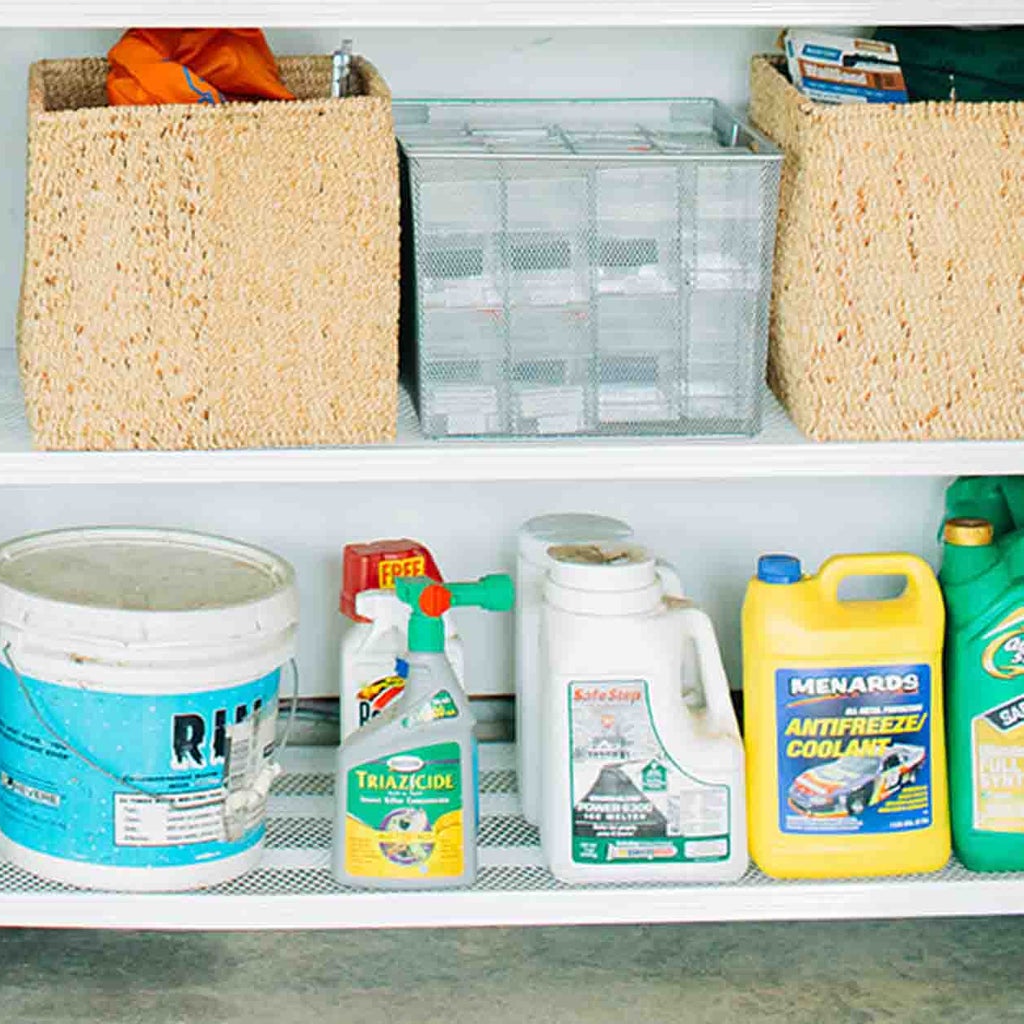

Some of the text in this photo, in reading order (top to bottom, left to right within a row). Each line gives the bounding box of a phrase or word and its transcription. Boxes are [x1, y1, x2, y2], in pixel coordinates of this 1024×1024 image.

[381, 557, 425, 587] FREE
[790, 675, 919, 694] MENARDS
[784, 713, 928, 736] ANTIFREEZE/
[787, 737, 891, 758] COOLANT
[355, 770, 455, 790] TRIAZICIDE
